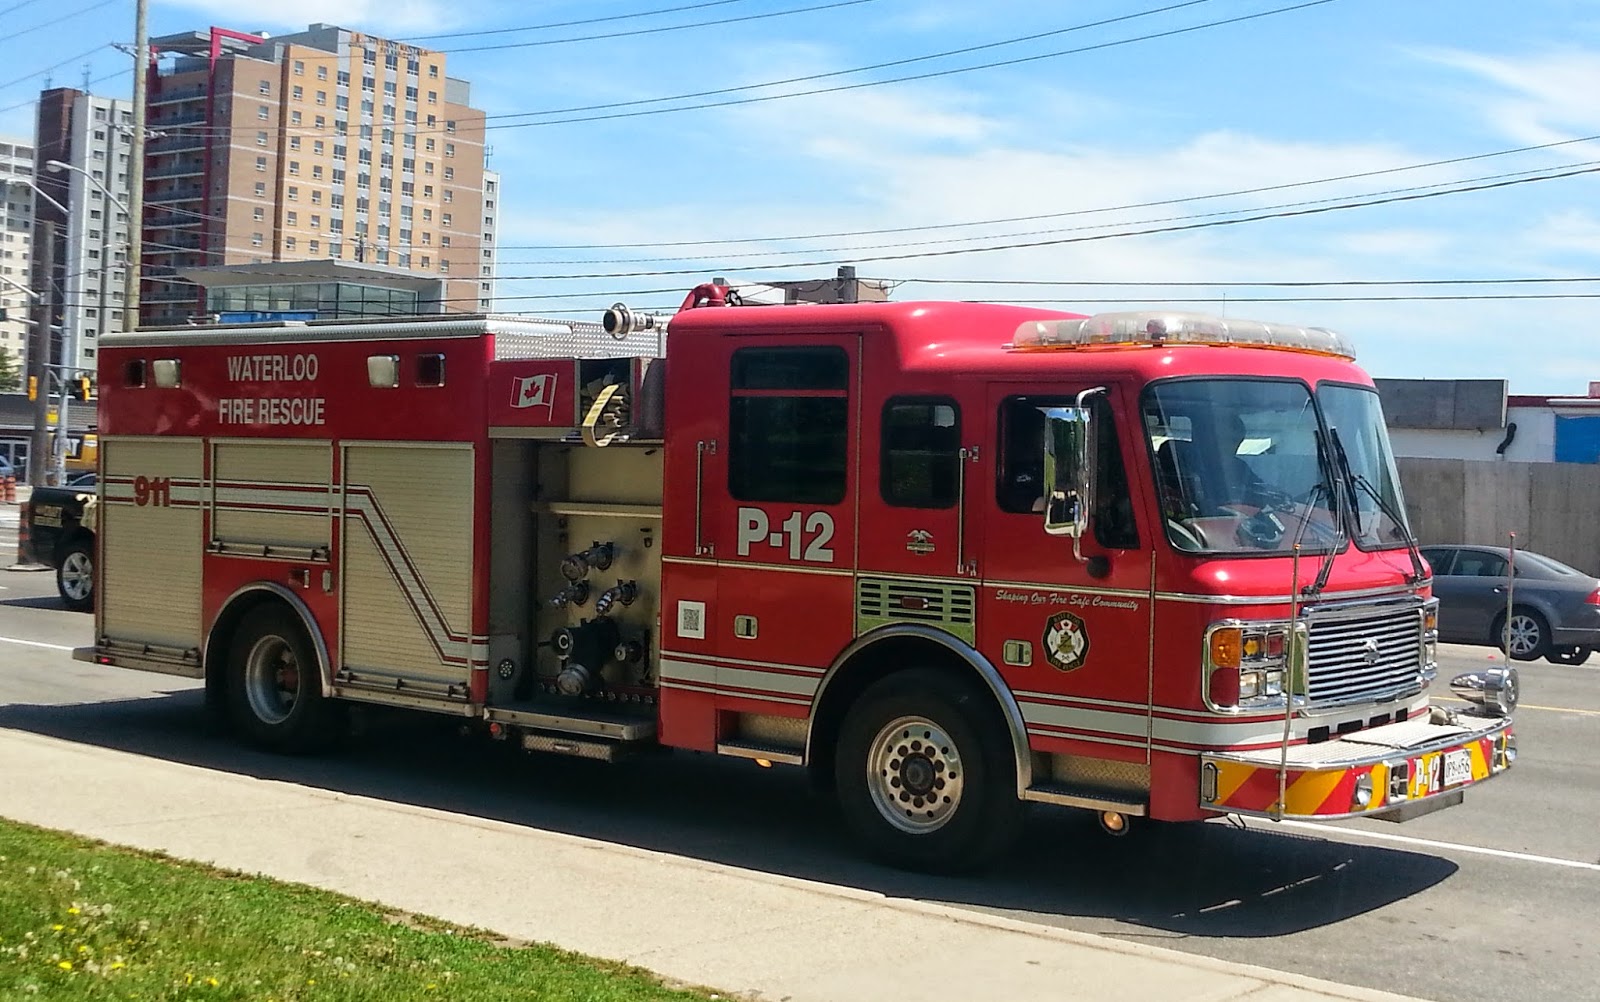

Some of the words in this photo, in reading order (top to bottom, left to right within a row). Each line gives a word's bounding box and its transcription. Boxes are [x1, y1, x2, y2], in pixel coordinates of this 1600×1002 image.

[228, 354, 318, 381] WATERLOO
[219, 398, 254, 425] FIRE
[258, 397, 326, 425] RESCUE
[133, 475, 171, 507] 911
[737, 506, 836, 563] P-12
[995, 589, 1028, 604] Shaping
[1030, 592, 1047, 605] Our
[1049, 593, 1068, 605] Fire
[1069, 594, 1090, 608] Safe
[1092, 595, 1139, 611] Community
[1413, 754, 1441, 796] P-12
